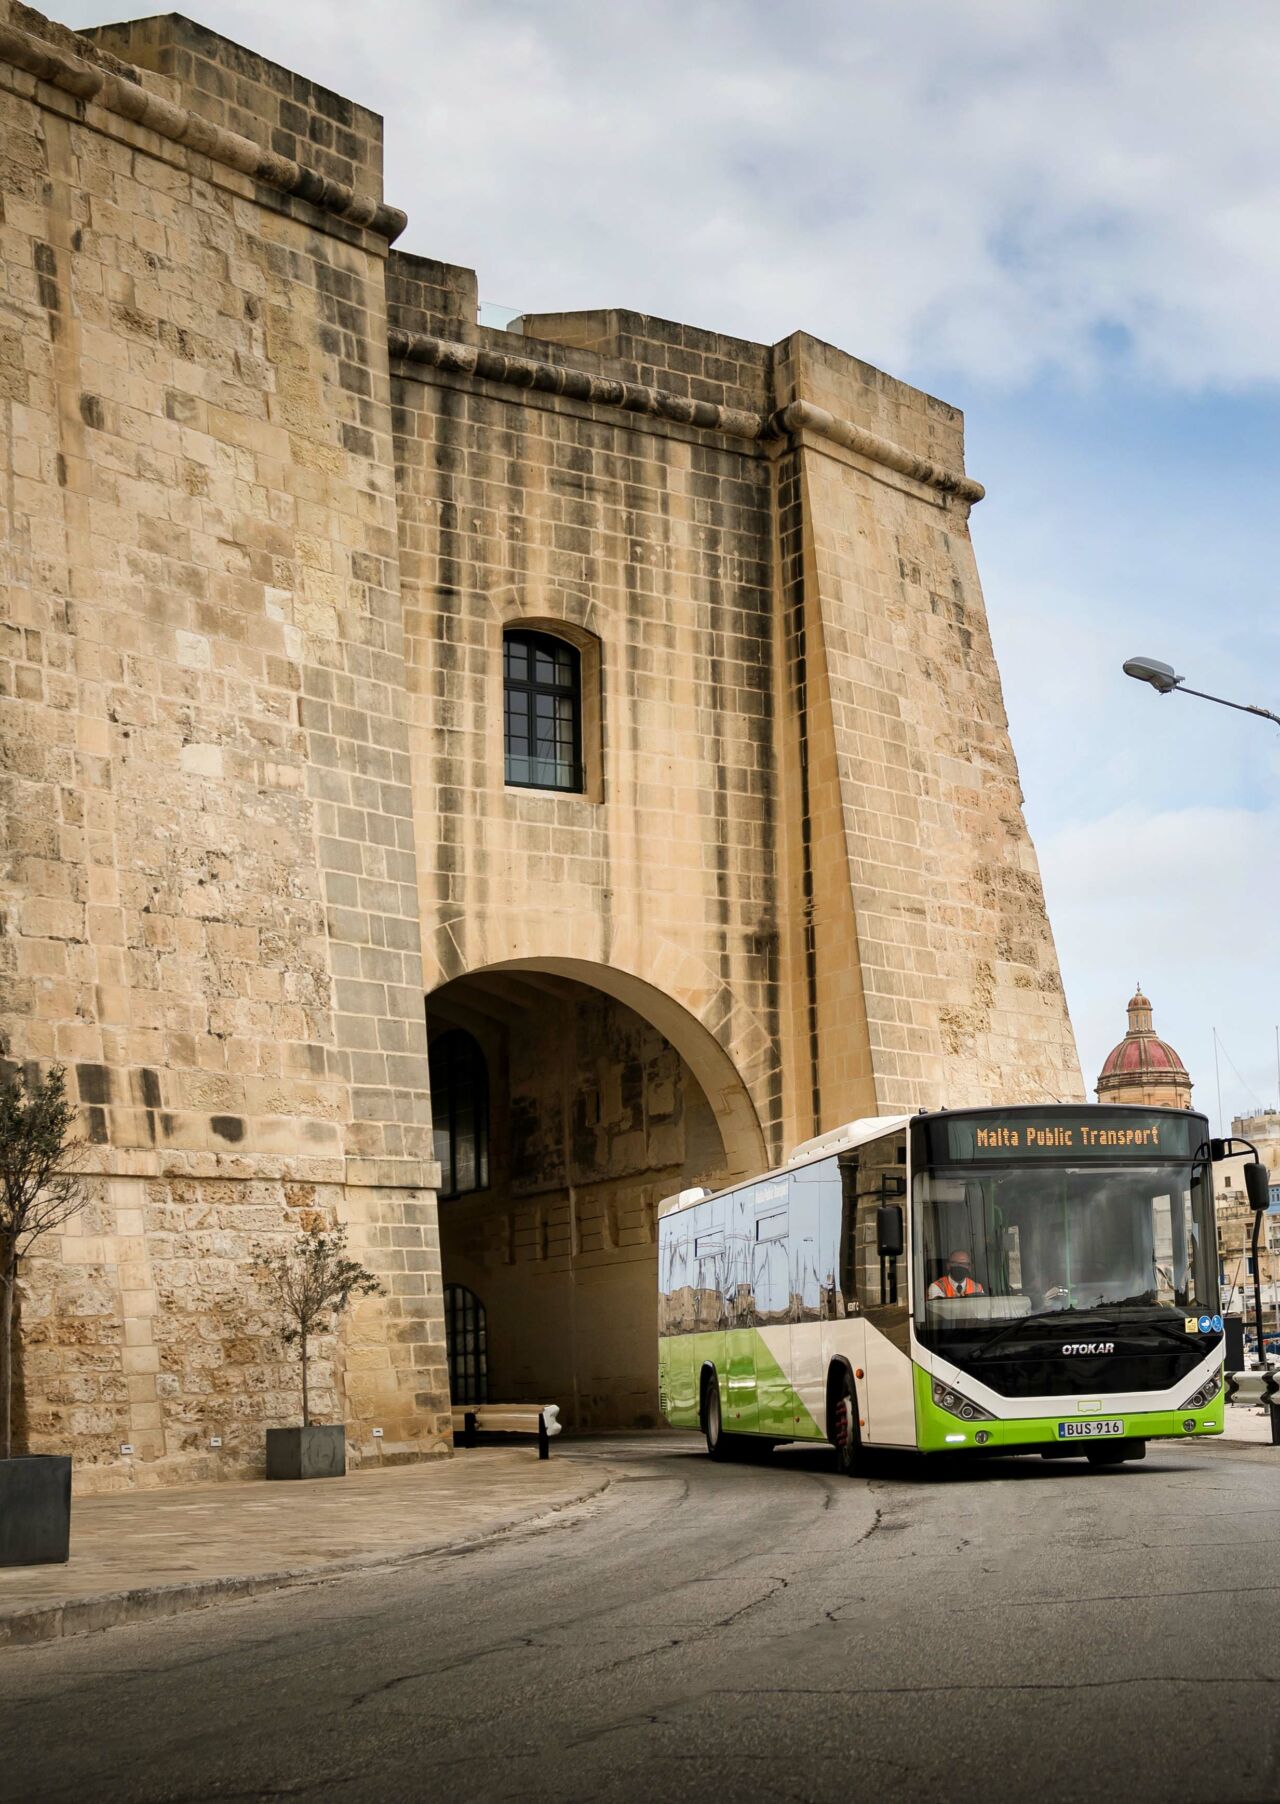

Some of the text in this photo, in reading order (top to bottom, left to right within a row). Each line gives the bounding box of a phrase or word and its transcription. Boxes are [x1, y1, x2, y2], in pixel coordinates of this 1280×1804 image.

[977, 1126, 1159, 1147] Malta Public Transport
[1062, 1343, 1115, 1355] OTOKAR
[1067, 1423, 1092, 1435] BUS
[1096, 1422, 1120, 1434] 916
